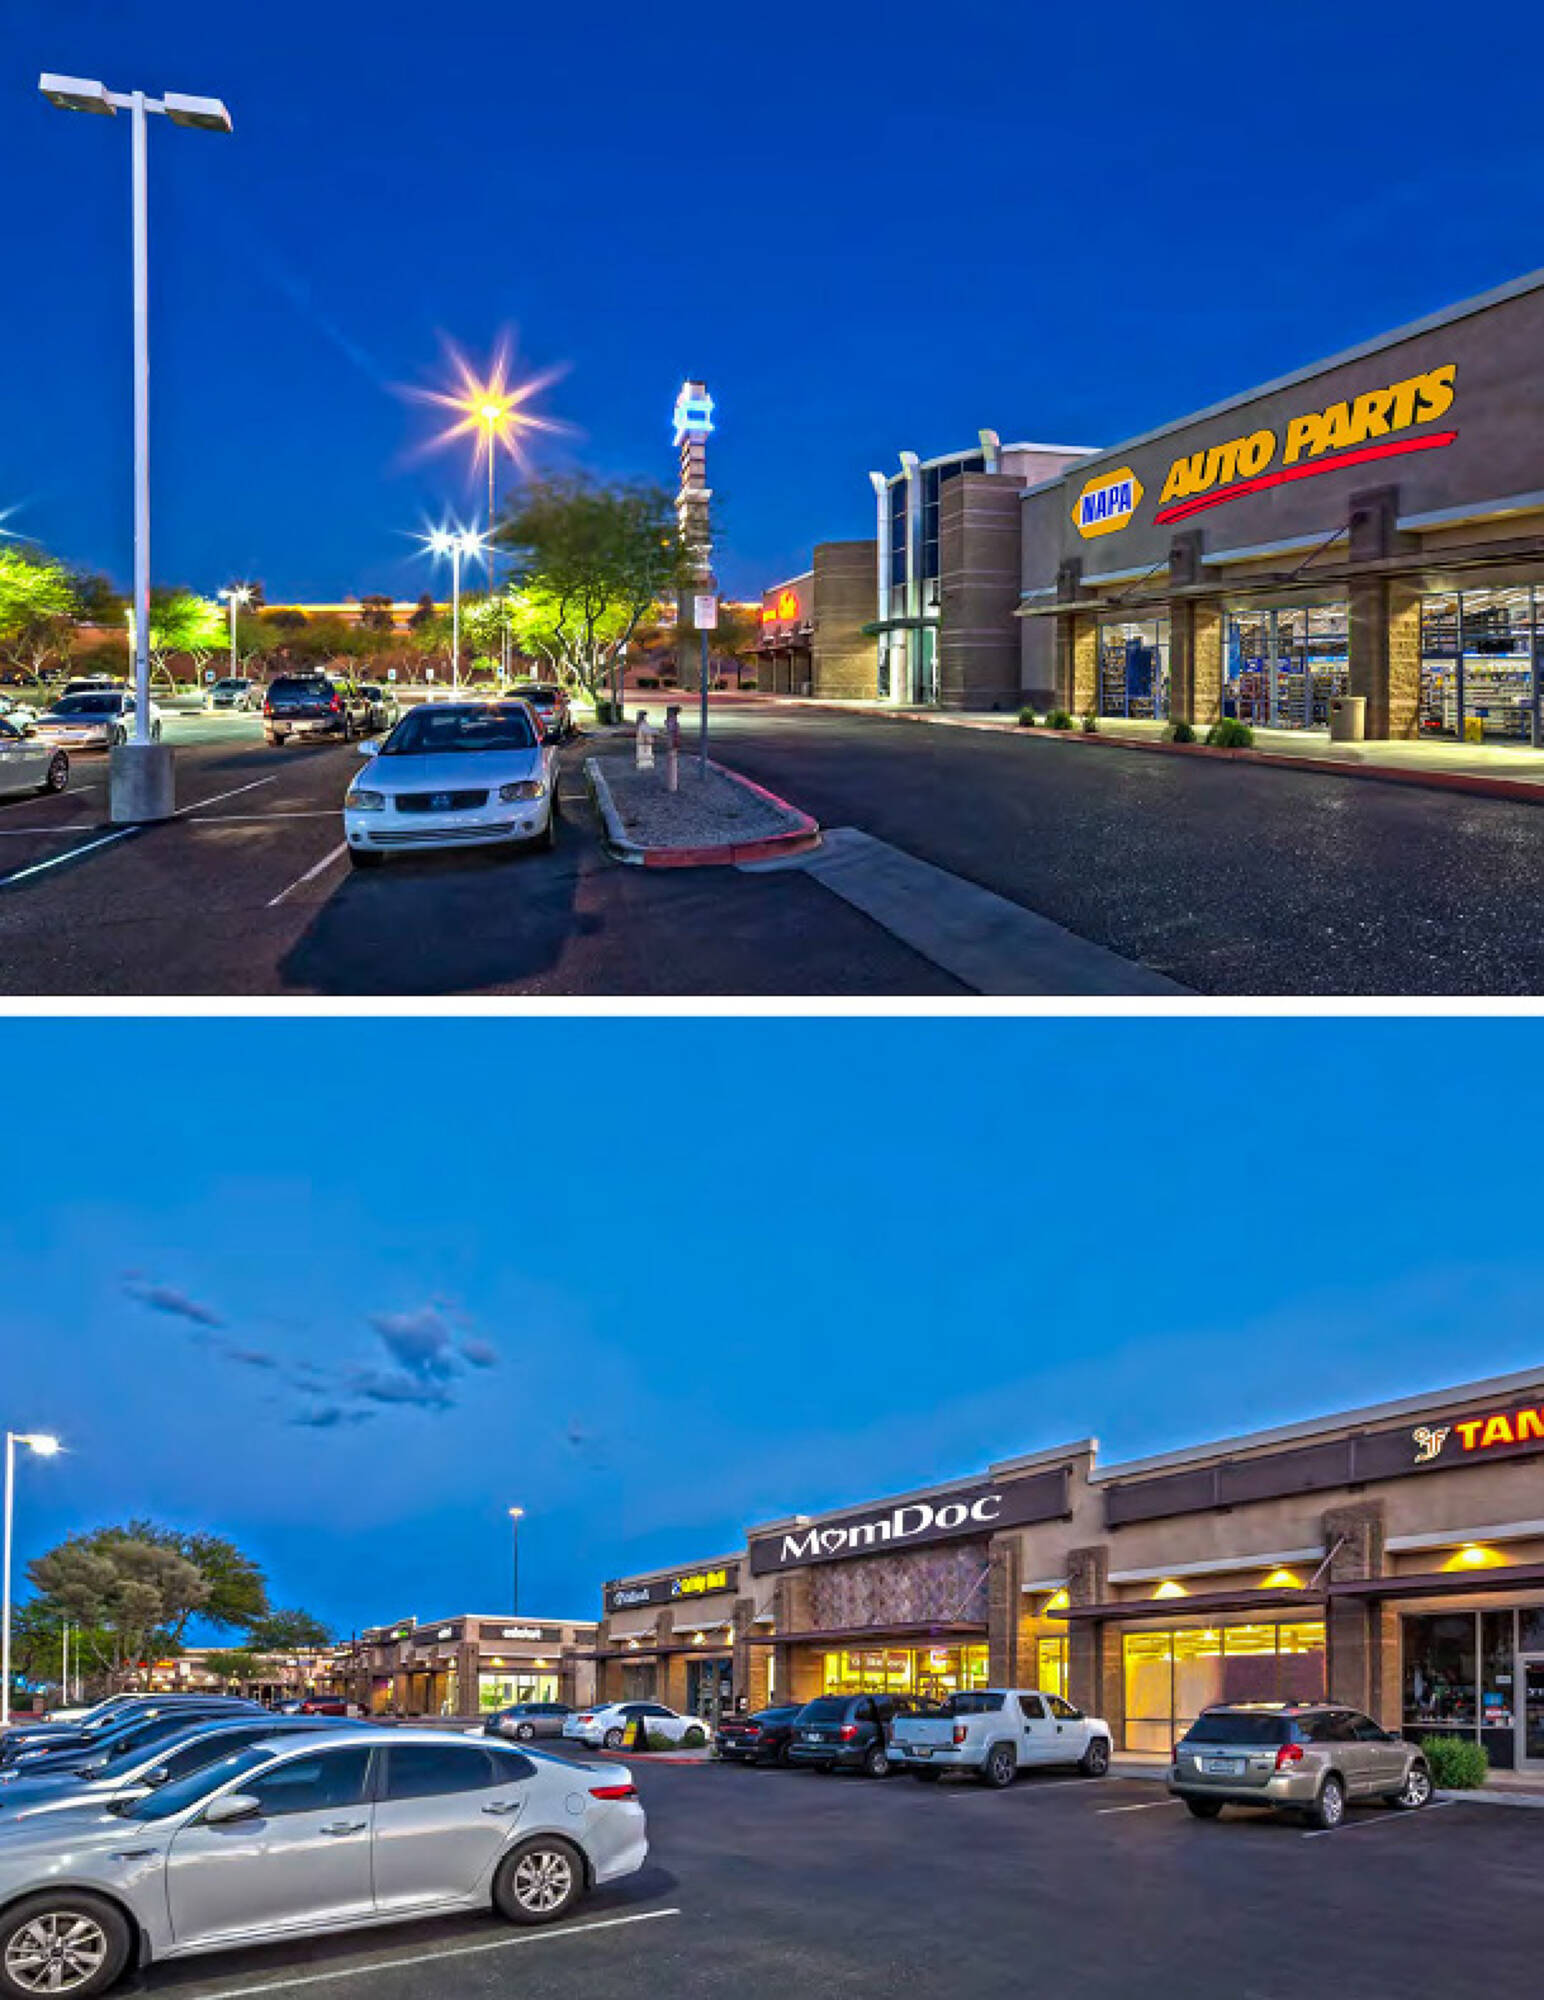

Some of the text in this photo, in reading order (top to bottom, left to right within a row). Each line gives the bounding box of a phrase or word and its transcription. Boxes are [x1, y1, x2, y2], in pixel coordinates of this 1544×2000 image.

[1158, 363, 1458, 504] AUTO PARTS
[1081, 482, 1132, 525] NAPA
[780, 1495, 1002, 1562] MomDoc
